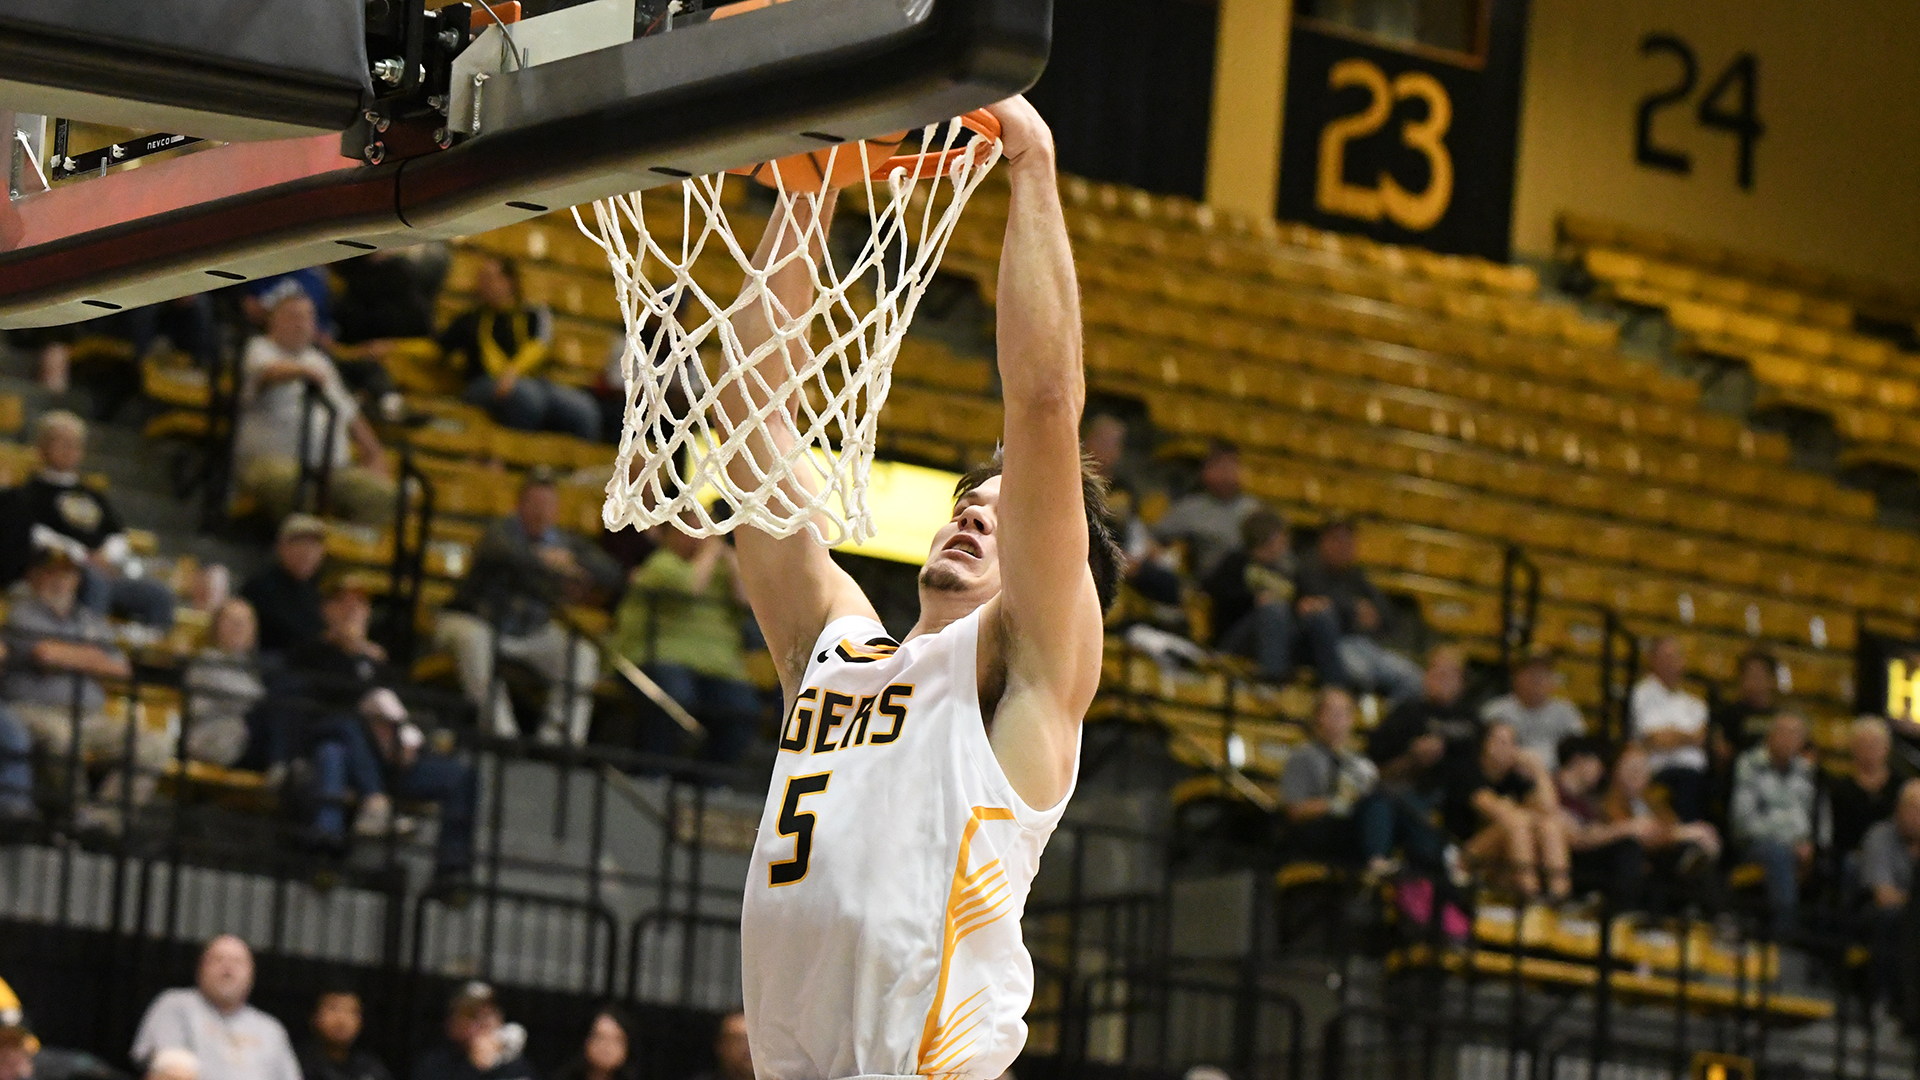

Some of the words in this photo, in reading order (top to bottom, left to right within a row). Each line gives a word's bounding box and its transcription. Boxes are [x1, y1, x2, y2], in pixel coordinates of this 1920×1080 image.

[147, 137, 170, 150] NEVCO
[1315, 58, 1454, 232] 23
[1635, 33, 1766, 190] 24
[768, 770, 833, 888] 5
